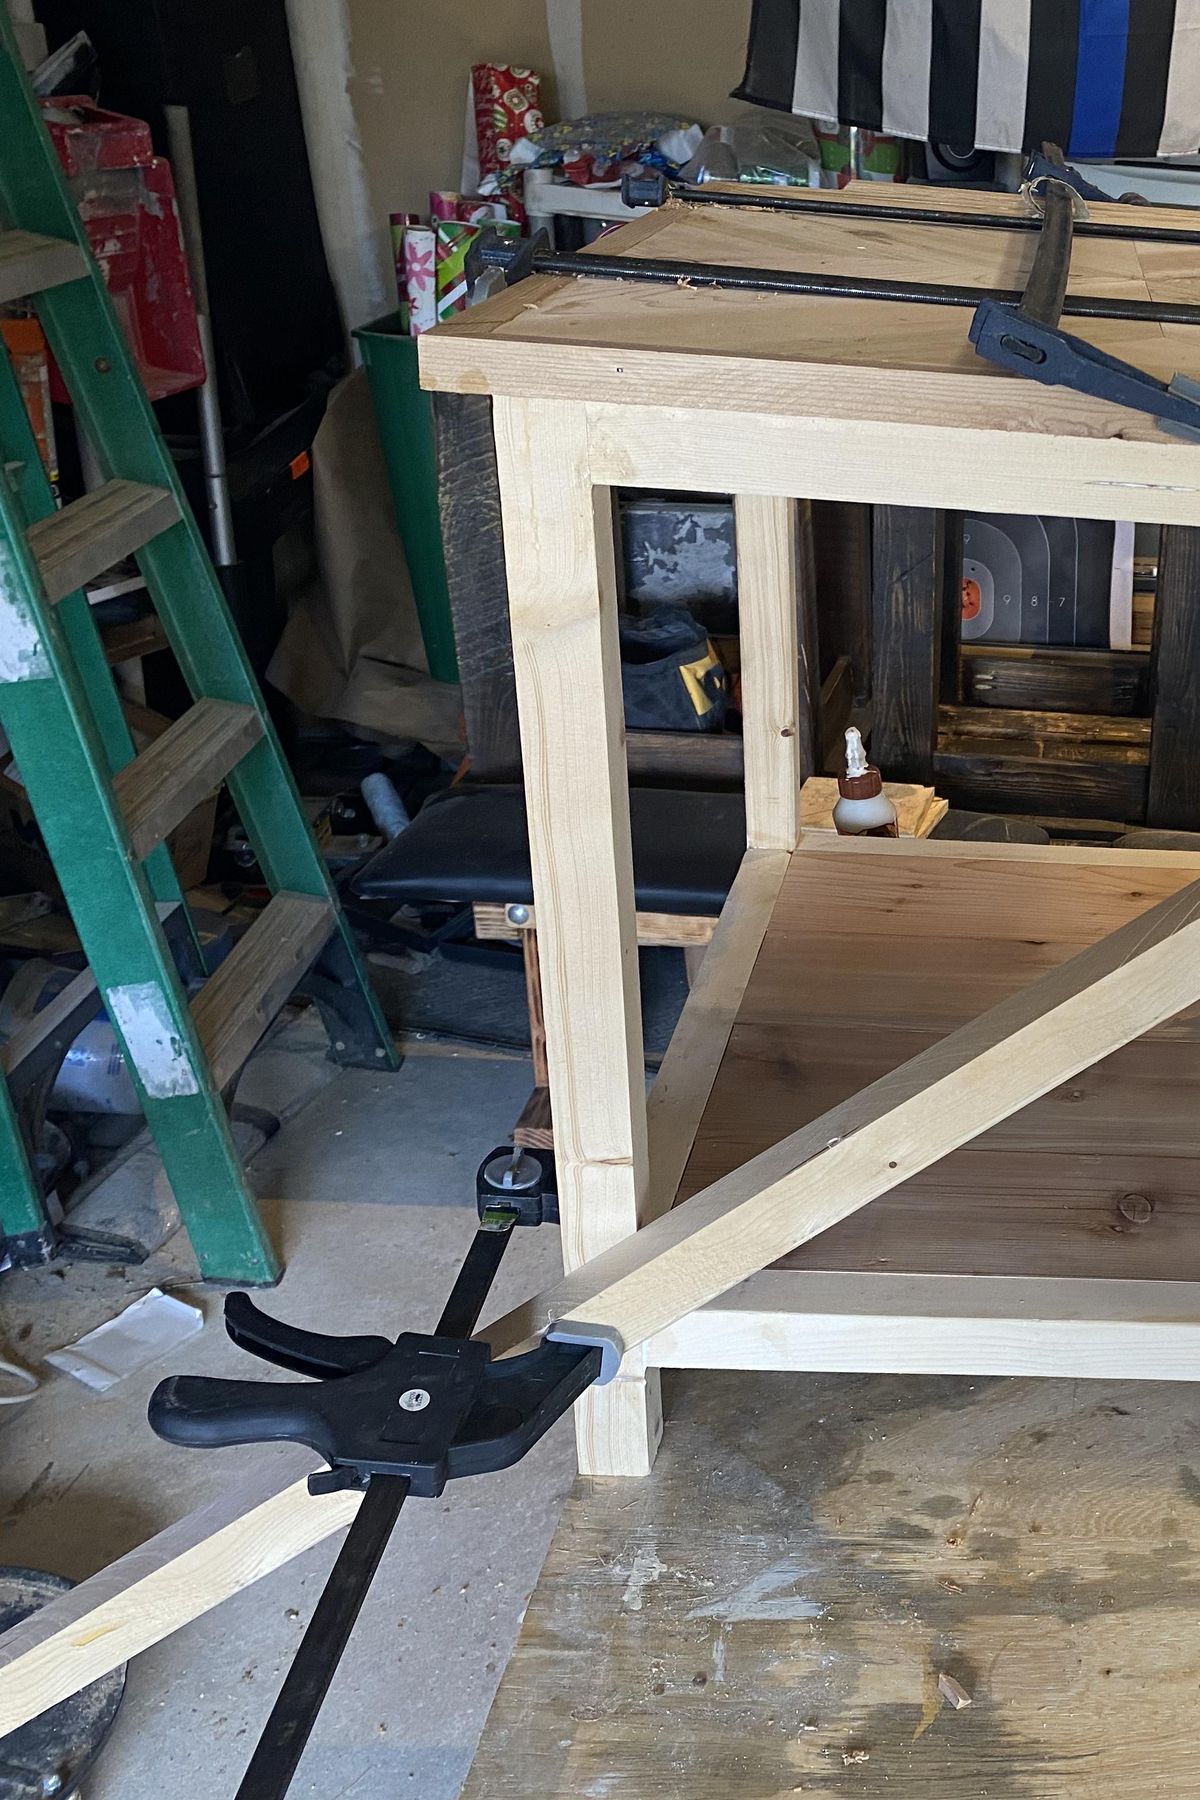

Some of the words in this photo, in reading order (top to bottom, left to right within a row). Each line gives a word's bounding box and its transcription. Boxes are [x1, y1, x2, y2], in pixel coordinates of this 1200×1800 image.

[1003, 594, 1011, 605] 9
[1031, 595, 1038, 607] 8
[1059, 597, 1066, 607] 7
